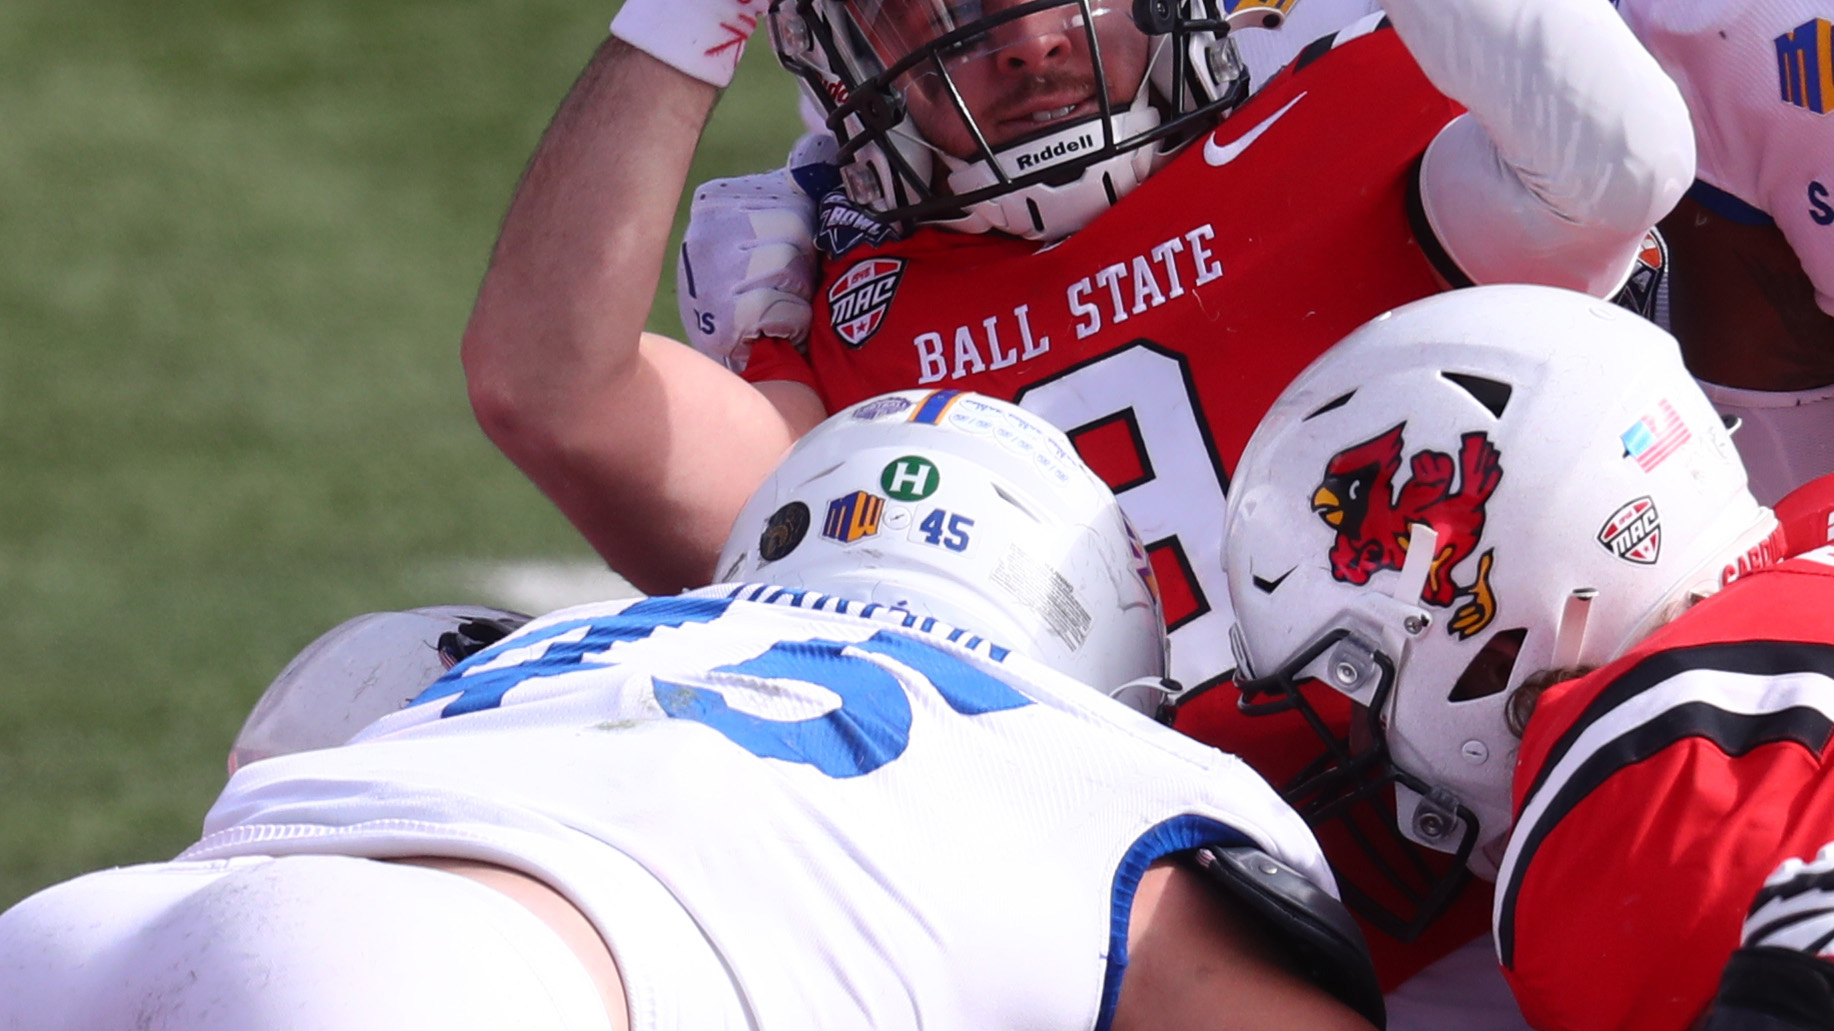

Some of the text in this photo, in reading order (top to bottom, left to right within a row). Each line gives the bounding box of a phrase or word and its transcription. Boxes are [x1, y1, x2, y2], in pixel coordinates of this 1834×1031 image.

[1016, 134, 1094, 171] Riddell
[831, 276, 896, 326] MAC
[913, 223, 1223, 385] BALL STATE
[889, 462, 931, 496] H
[919, 508, 975, 553] 45
[1611, 508, 1658, 557] MAC
